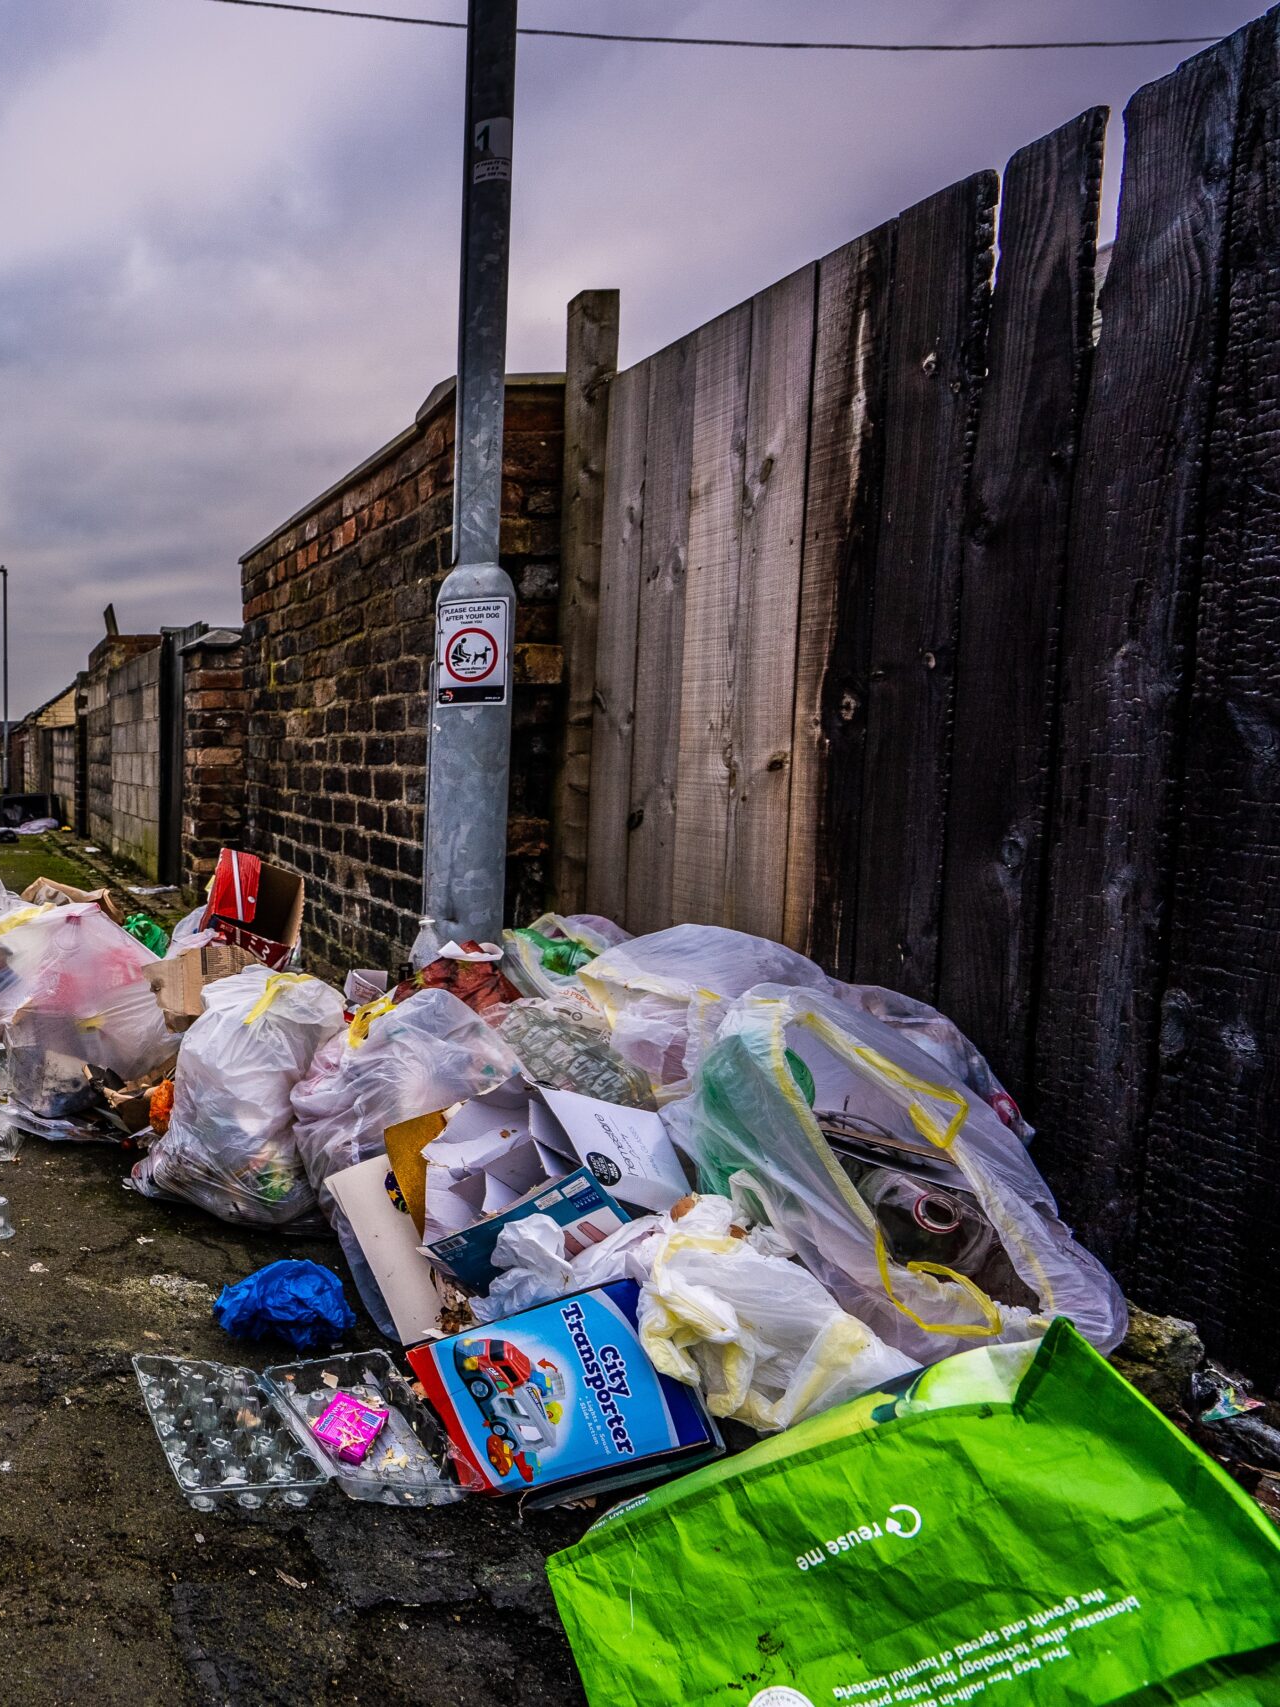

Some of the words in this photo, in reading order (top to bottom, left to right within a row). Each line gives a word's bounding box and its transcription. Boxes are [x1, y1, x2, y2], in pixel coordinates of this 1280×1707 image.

[444, 607, 467, 615] PLEASE
[560, 1301, 634, 1455] Transporter
[599, 1345, 631, 1397] City
[579, 1402, 589, 1421] Slide
[587, 1421, 599, 1446] Action
[586, 1400, 598, 1423] Lights
[600, 1433, 611, 1455] Sound
[609, 1509, 624, 1520] Live
[825, 1522, 883, 1555] reuse
[796, 1547, 826, 1571] me
[1080, 1588, 1106, 1605] the
[1028, 1596, 1080, 1628] growth
[1070, 1594, 1141, 1632] biomaster
[1000, 1619, 1028, 1641] and
[1031, 1626, 1067, 1649] silver
[954, 1630, 1000, 1660] spread
[1042, 1645, 1070, 1662] This
[939, 1650, 953, 1667] of
[959, 1642, 1030, 1677] technology
[1012, 1657, 1041, 1675] bag
[889, 1656, 940, 1686] harmful
[930, 1670, 958, 1689] that
[987, 1670, 1012, 1684] has
[832, 1676, 890, 1699] bacteria
[894, 1681, 931, 1700] helps
